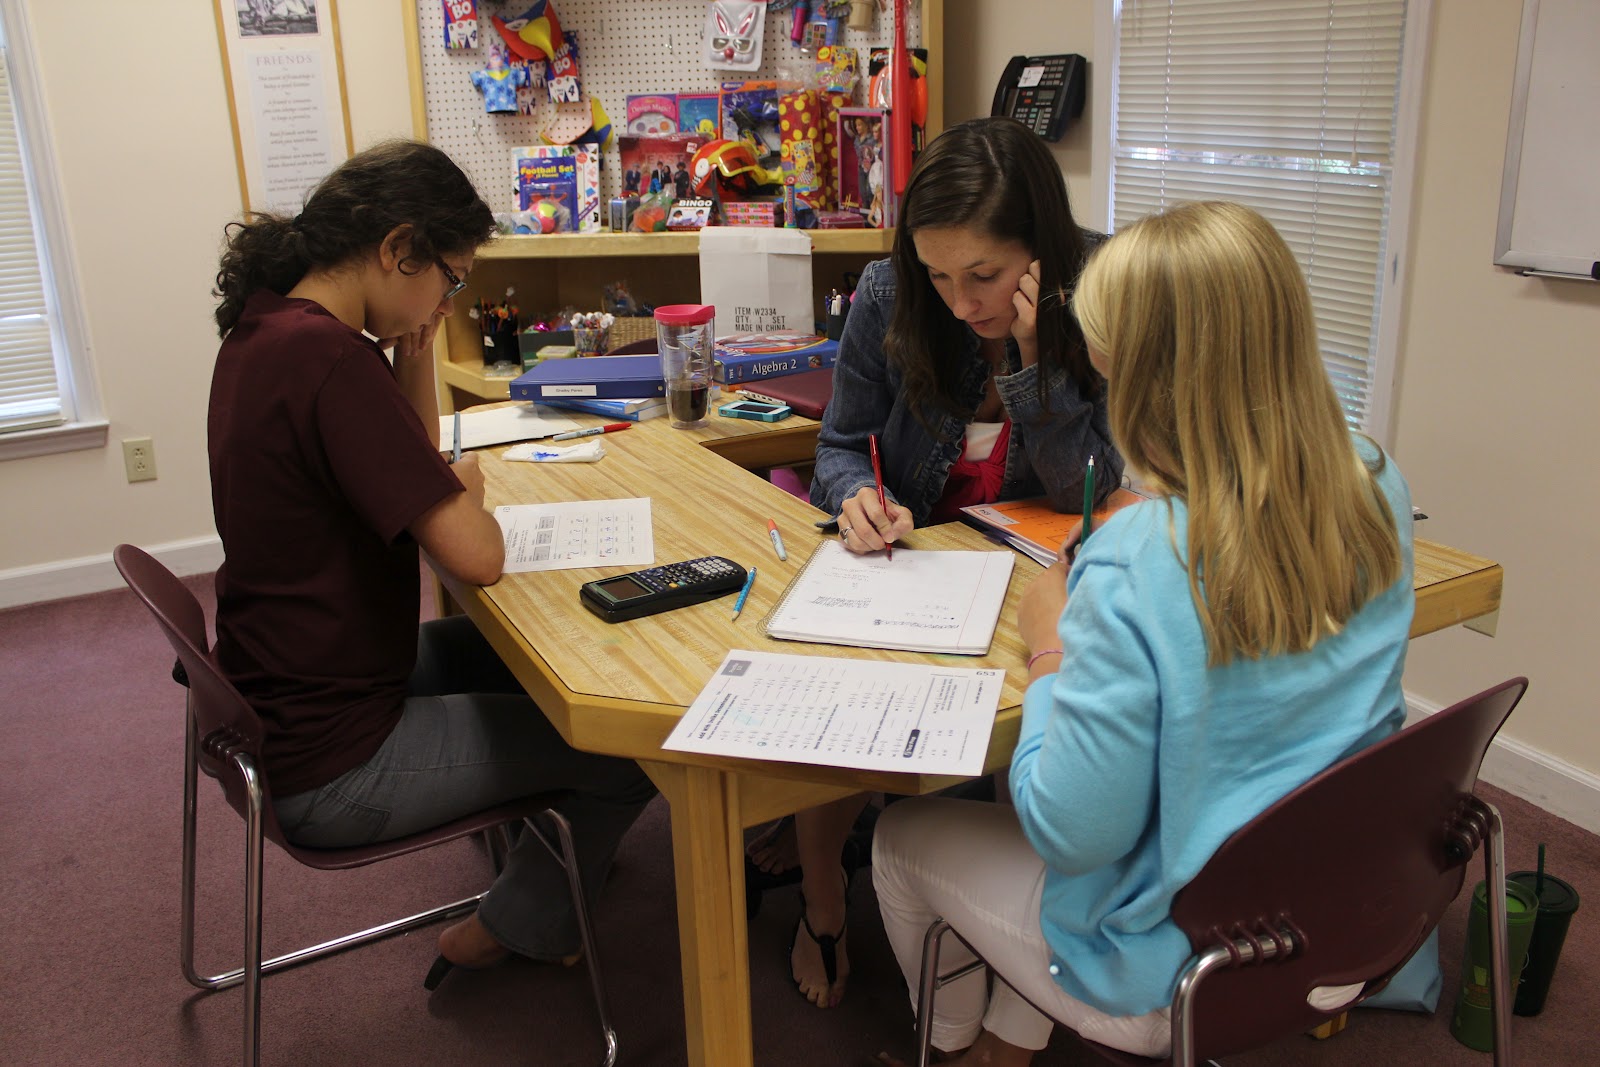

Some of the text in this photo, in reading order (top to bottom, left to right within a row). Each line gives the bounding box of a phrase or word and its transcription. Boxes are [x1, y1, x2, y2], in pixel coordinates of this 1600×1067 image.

[452, 1, 472, 20] BO
[256, 54, 312, 66] FRIENDS
[554, 56, 570, 74] BO
[568, 84, 574, 96] 4
[632, 102, 671, 113] Design Magic!
[520, 165, 574, 175] Football Set
[735, 307, 750, 315] ITEM
[752, 359, 797, 375] Algebra 2
